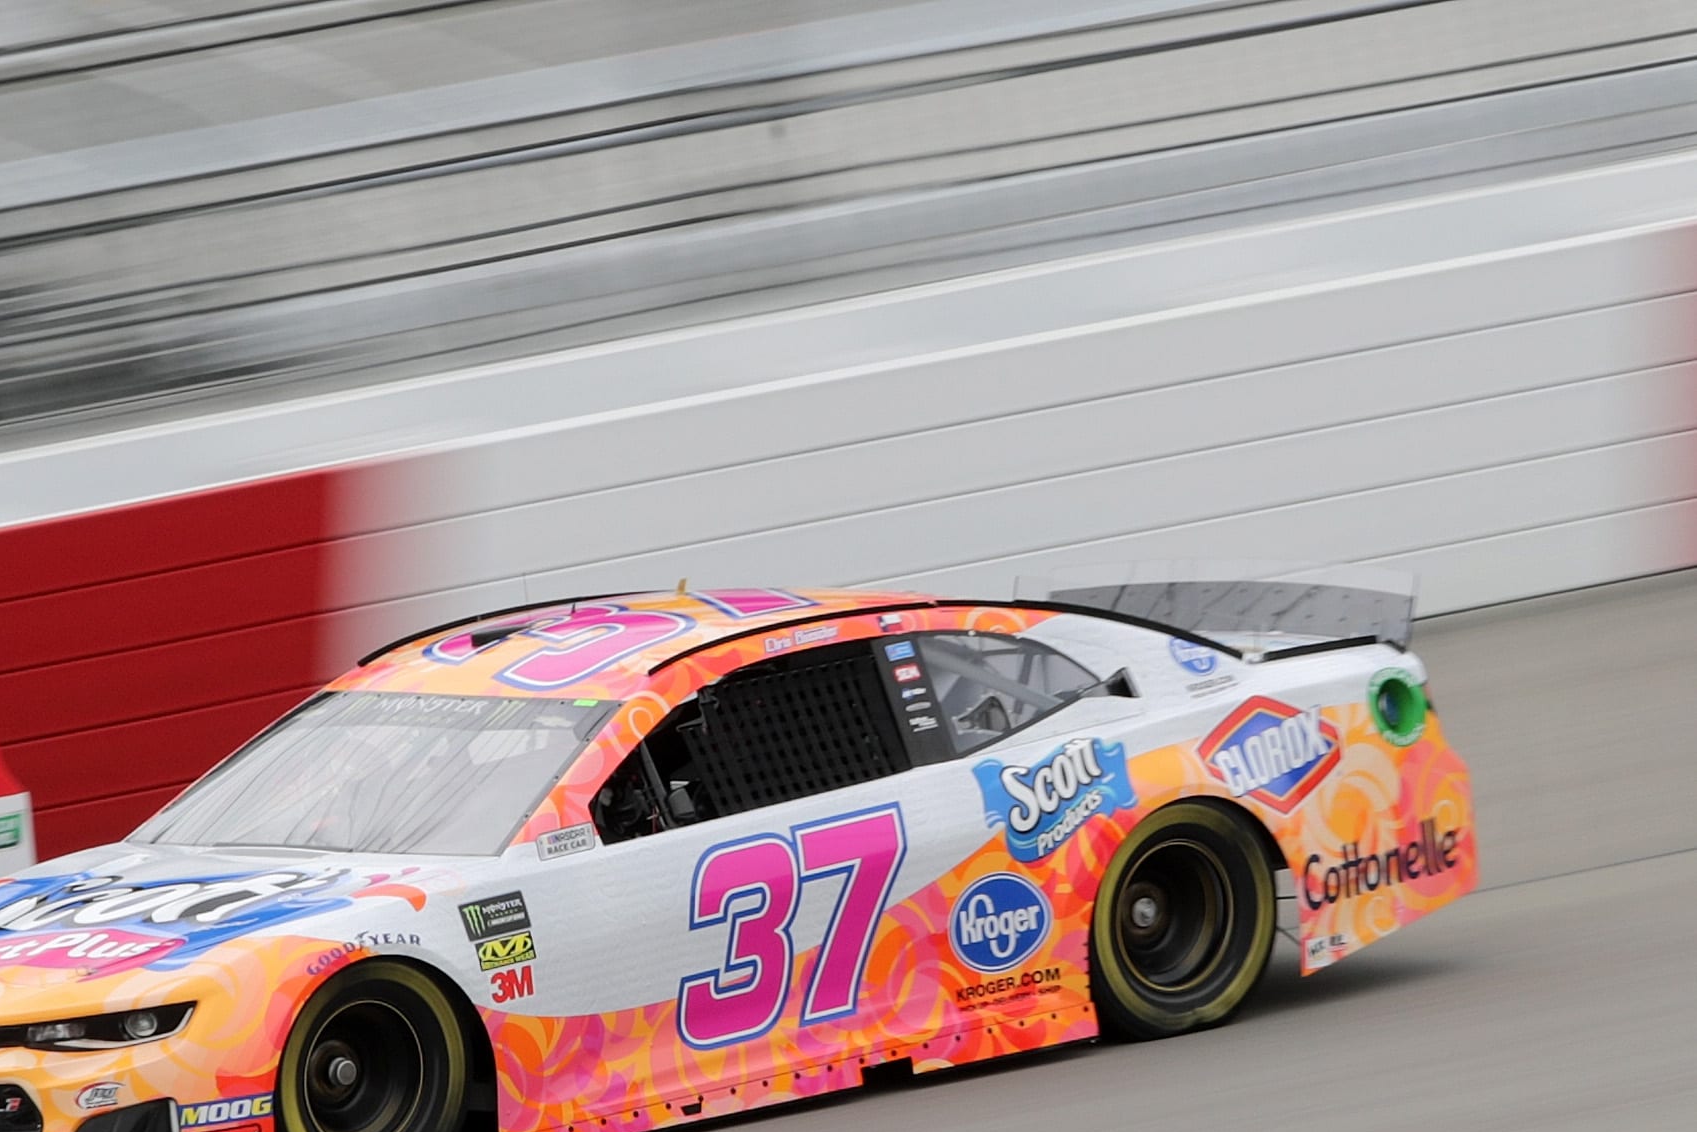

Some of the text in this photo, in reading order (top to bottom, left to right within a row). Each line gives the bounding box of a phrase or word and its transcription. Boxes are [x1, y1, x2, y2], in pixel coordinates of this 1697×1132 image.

[1214, 708, 1329, 798] CLOROX
[1001, 738, 1102, 832] Scott
[547, 839, 588, 855] RACE CAR
[1037, 788, 1103, 858] Products
[1305, 818, 1459, 910] Cottonelle
[30, 932, 168, 960] Plus
[306, 930, 422, 976] GOODYEAR
[676, 801, 908, 1051] 37
[959, 893, 1042, 958] Kroger
[490, 965, 535, 1004] 3M
[956, 967, 1061, 1002] KROGER.COM
[180, 1094, 273, 1127] MOOG
